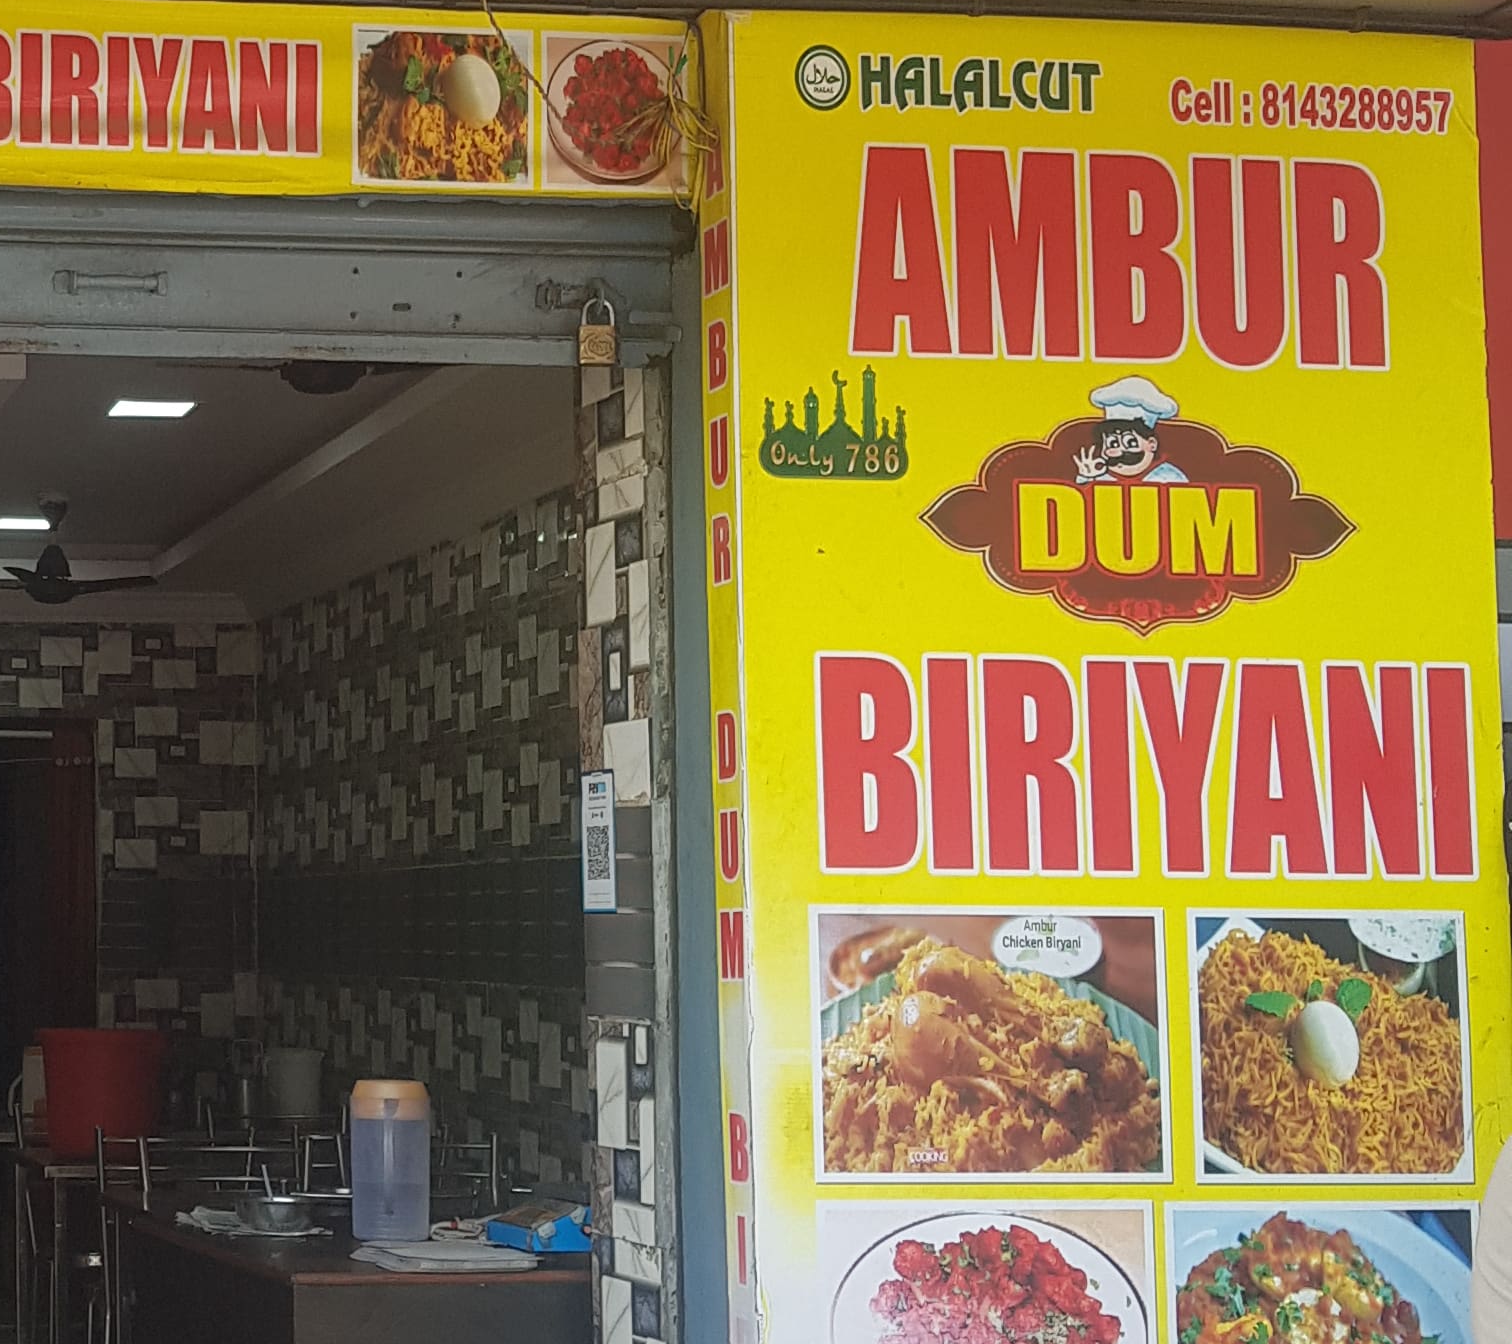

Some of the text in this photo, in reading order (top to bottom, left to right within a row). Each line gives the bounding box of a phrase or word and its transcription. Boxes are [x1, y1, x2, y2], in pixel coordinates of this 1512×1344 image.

[858, 53, 1104, 115] HALALCUT
[1169, 77, 1233, 125] Cell
[1260, 81, 1454, 135] 8143288957
[849, 143, 1390, 372] AMBUR
[770, 441, 900, 476] Only 786
[1015, 483, 1265, 578] DUM
[814, 652, 1481, 881] BIRIYANI
[1002, 935, 1082, 952] Chicken Biryani
[1023, 919, 1058, 933] Ambur
